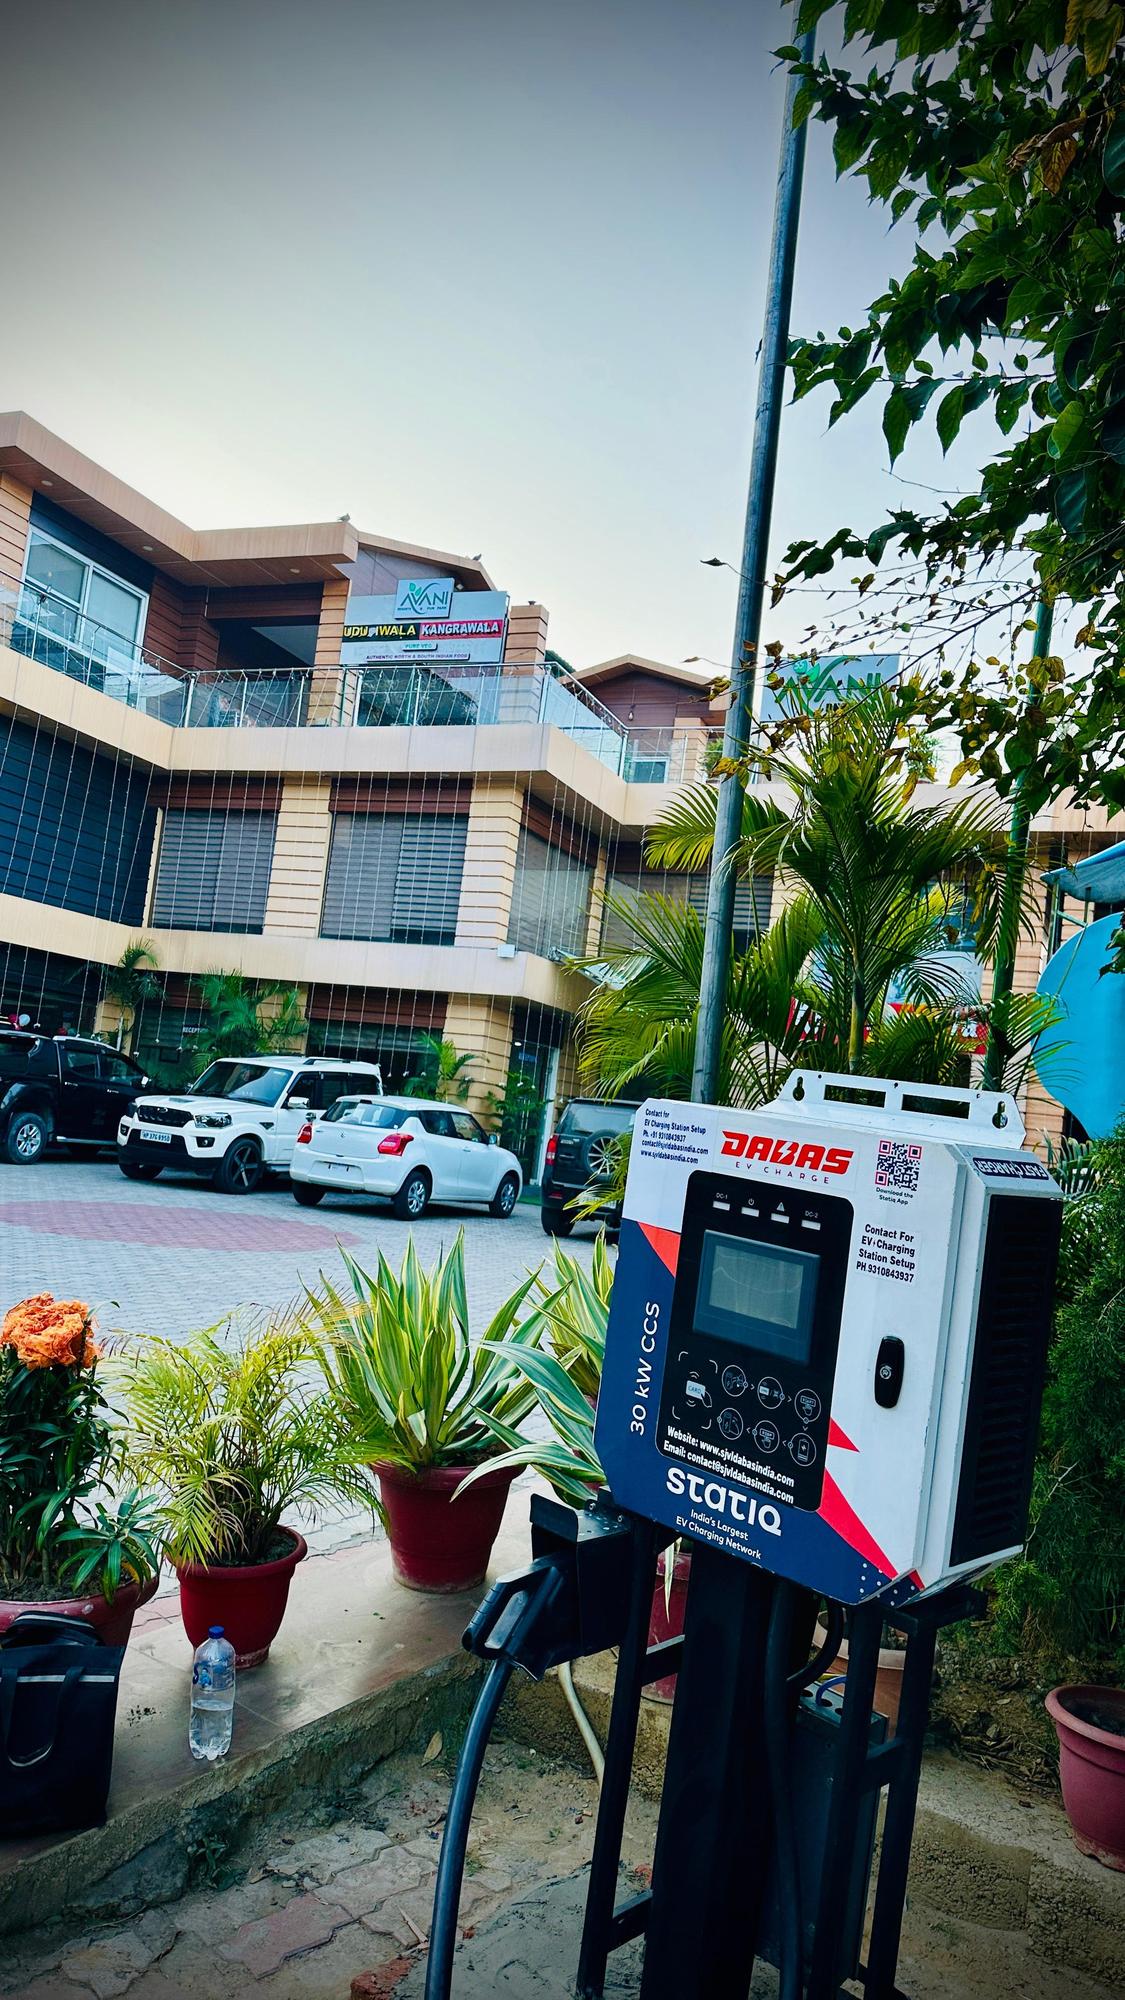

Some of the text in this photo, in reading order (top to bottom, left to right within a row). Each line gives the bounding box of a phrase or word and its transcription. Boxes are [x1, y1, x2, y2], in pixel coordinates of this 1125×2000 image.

[343, 621, 500, 638] UDUIWALA KANGRAWALA
[645, 1108, 663, 1118] Contact
[644, 1118, 707, 1136] EV Charging Station Setup
[720, 1130, 855, 1175] DABAS
[735, 1161, 830, 1184] EV CHARGE
[974, 1159, 1048, 1178] FAST CHARGER
[875, 1186, 914, 1199] Download the
[897, 1198, 909, 1206] App
[804, 1210, 819, 1219] DC-2
[864, 1223, 915, 1243] Contact For
[861, 1235, 916, 1258] EV Charging
[858, 1247, 916, 1272] Station Setup
[867, 1263, 915, 1283] 9310843937
[630, 1301, 660, 1436] 30 kW CCS
[667, 1424, 699, 1448] Website:
[663, 1439, 687, 1459] Email:
[690, 1508, 749, 1541] India's Largest
[675, 1515, 762, 1560] EV Charging Network
